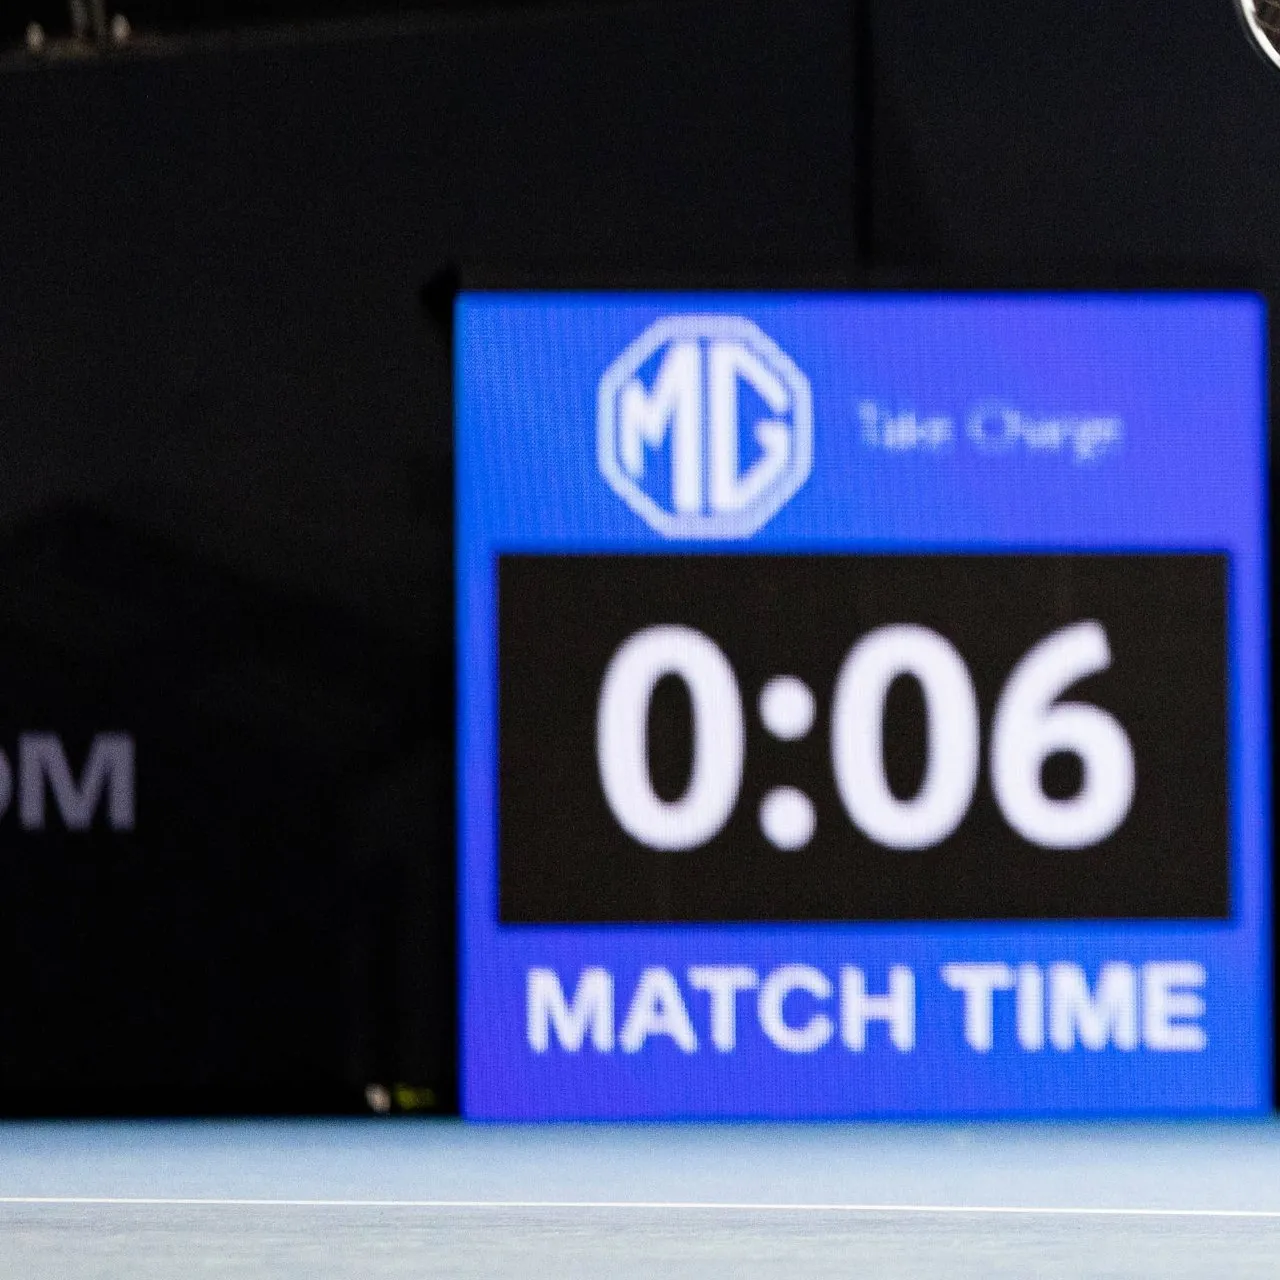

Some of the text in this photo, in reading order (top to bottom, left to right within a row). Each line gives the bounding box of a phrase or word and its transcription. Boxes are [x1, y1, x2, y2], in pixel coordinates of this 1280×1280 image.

[616, 334, 794, 517] MG
[0, 728, 137, 833] M
[597, 618, 1137, 852] 0:06
[525, 960, 1208, 1056] MATCH TIME
